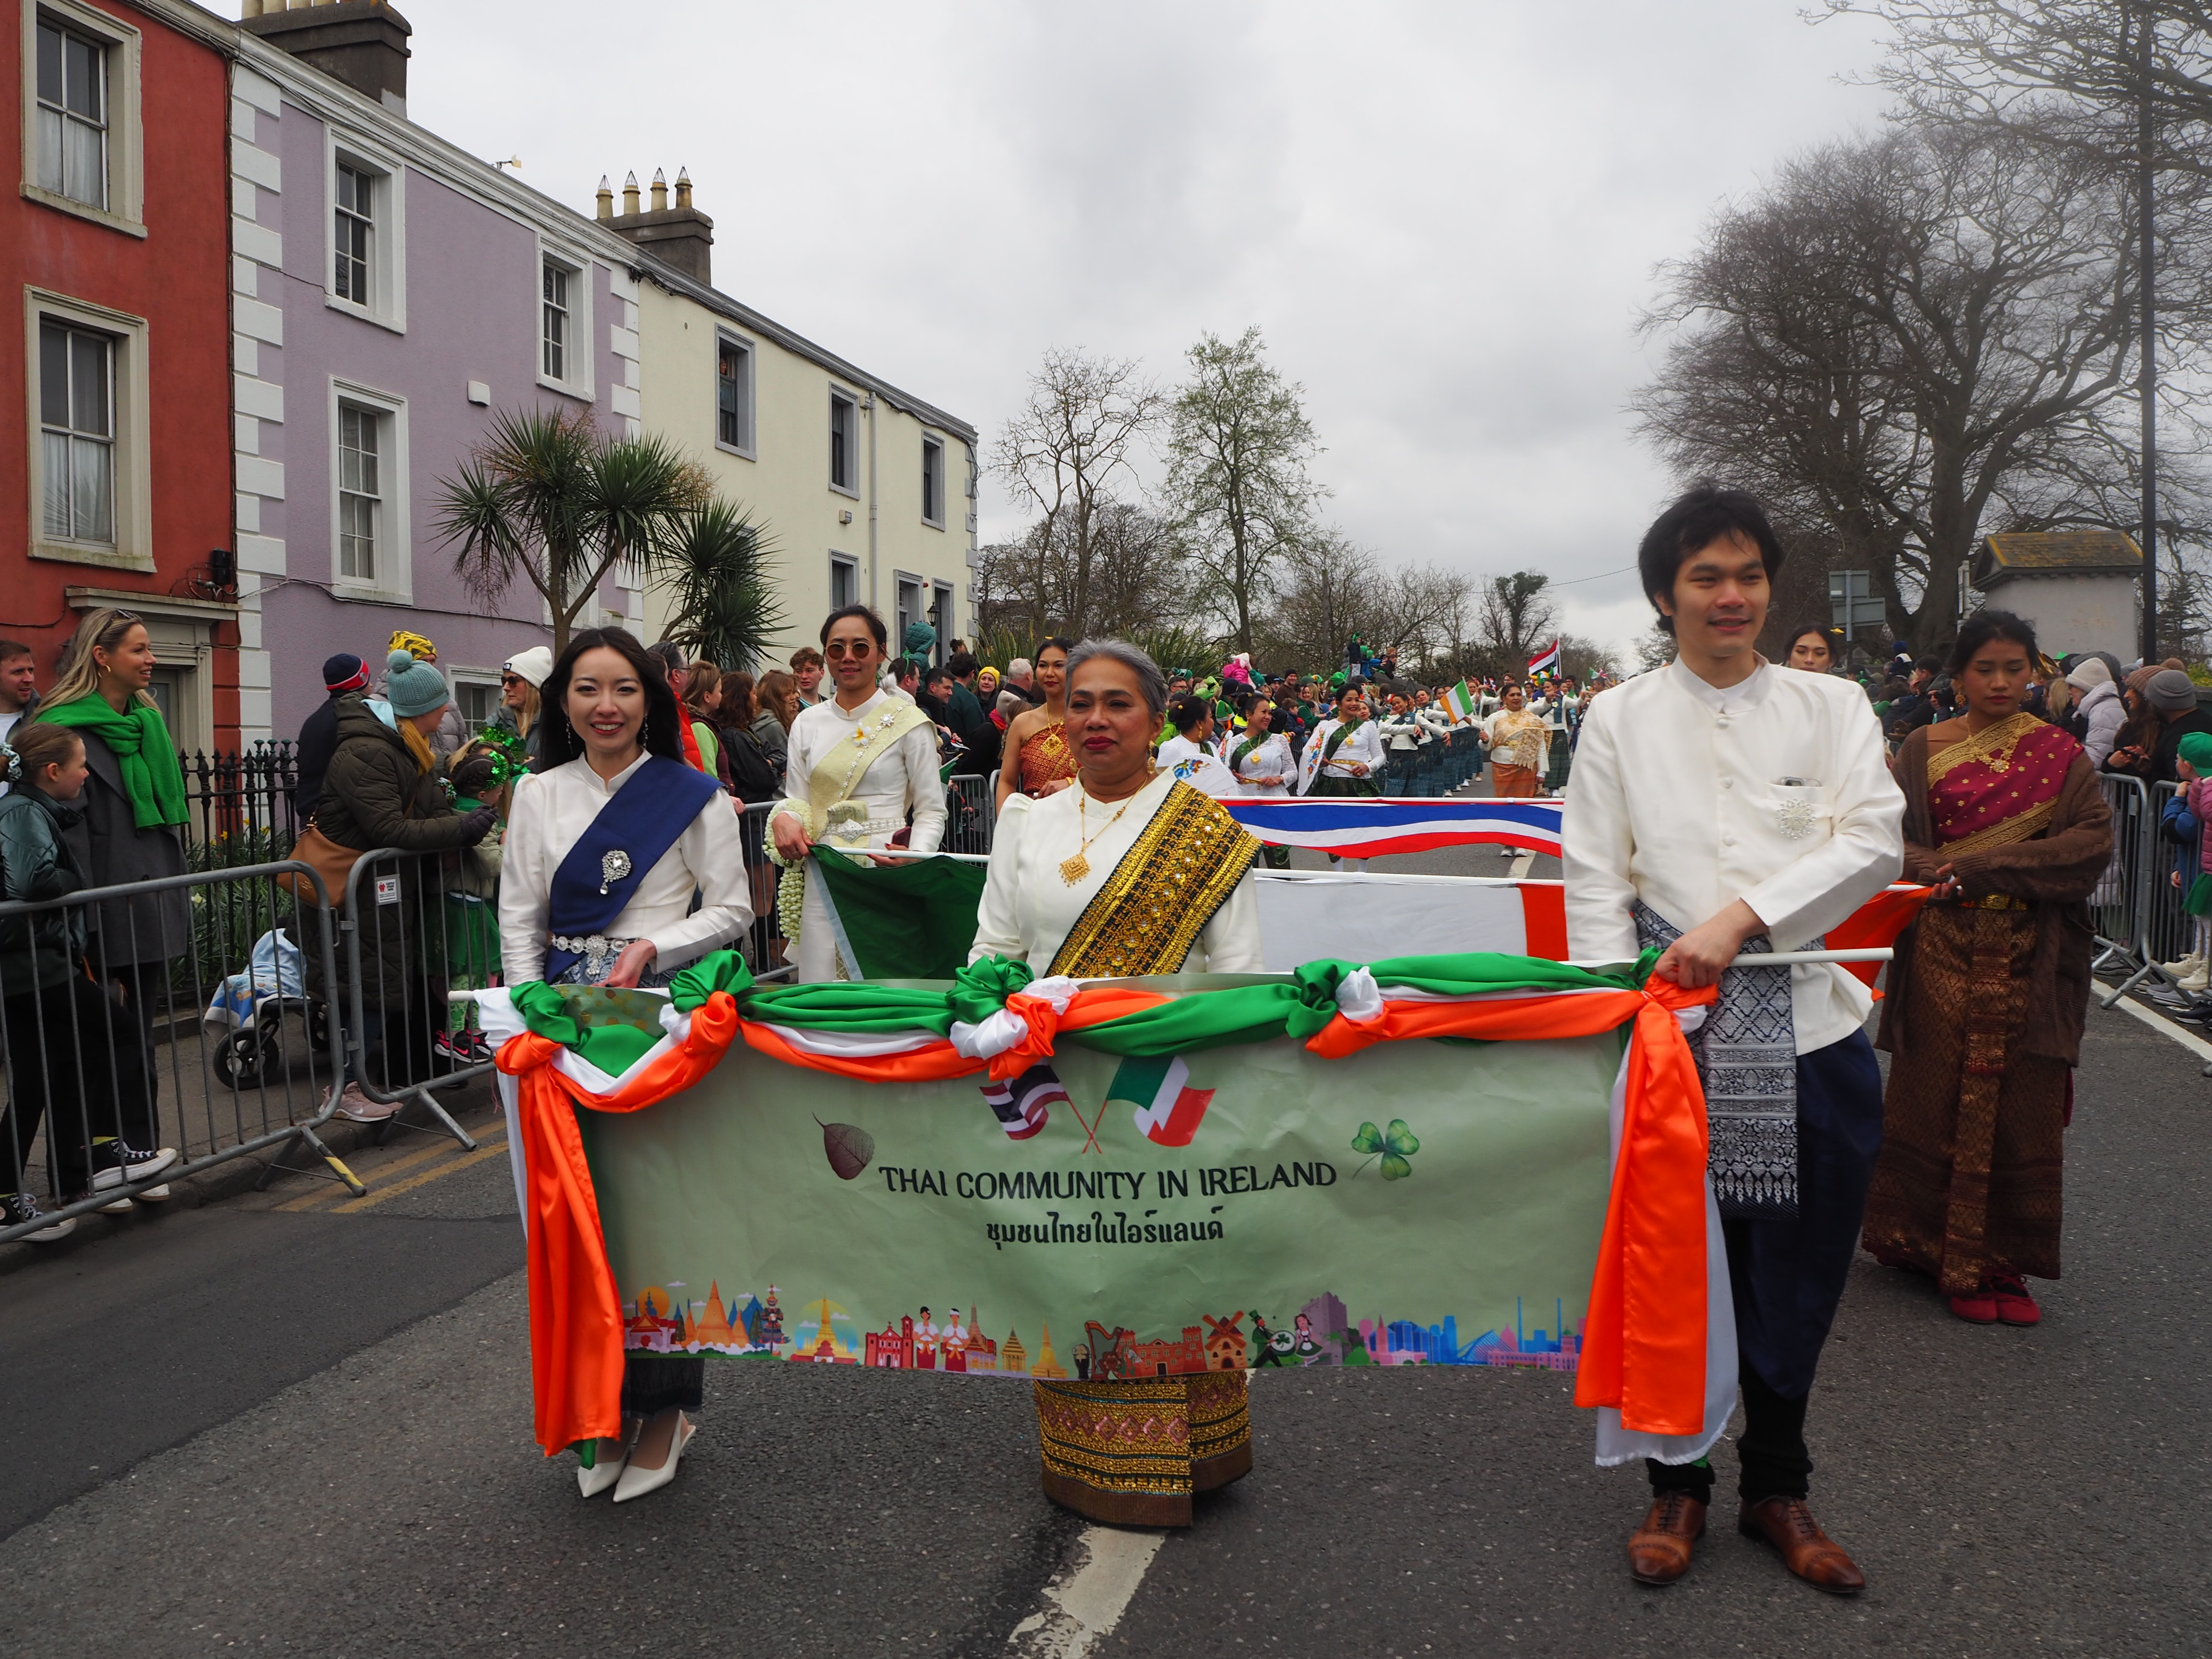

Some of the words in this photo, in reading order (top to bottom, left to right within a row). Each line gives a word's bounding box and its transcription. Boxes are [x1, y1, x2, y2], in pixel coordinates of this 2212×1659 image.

[878, 1166, 948, 1197] THAI
[956, 1170, 1146, 1200] COMMUNITY
[1157, 1169, 1189, 1199] IN
[1199, 1162, 1337, 1196] IRELAND
[986, 1205, 1224, 1250] ชุมชนไทยในไอร์แลนด์
